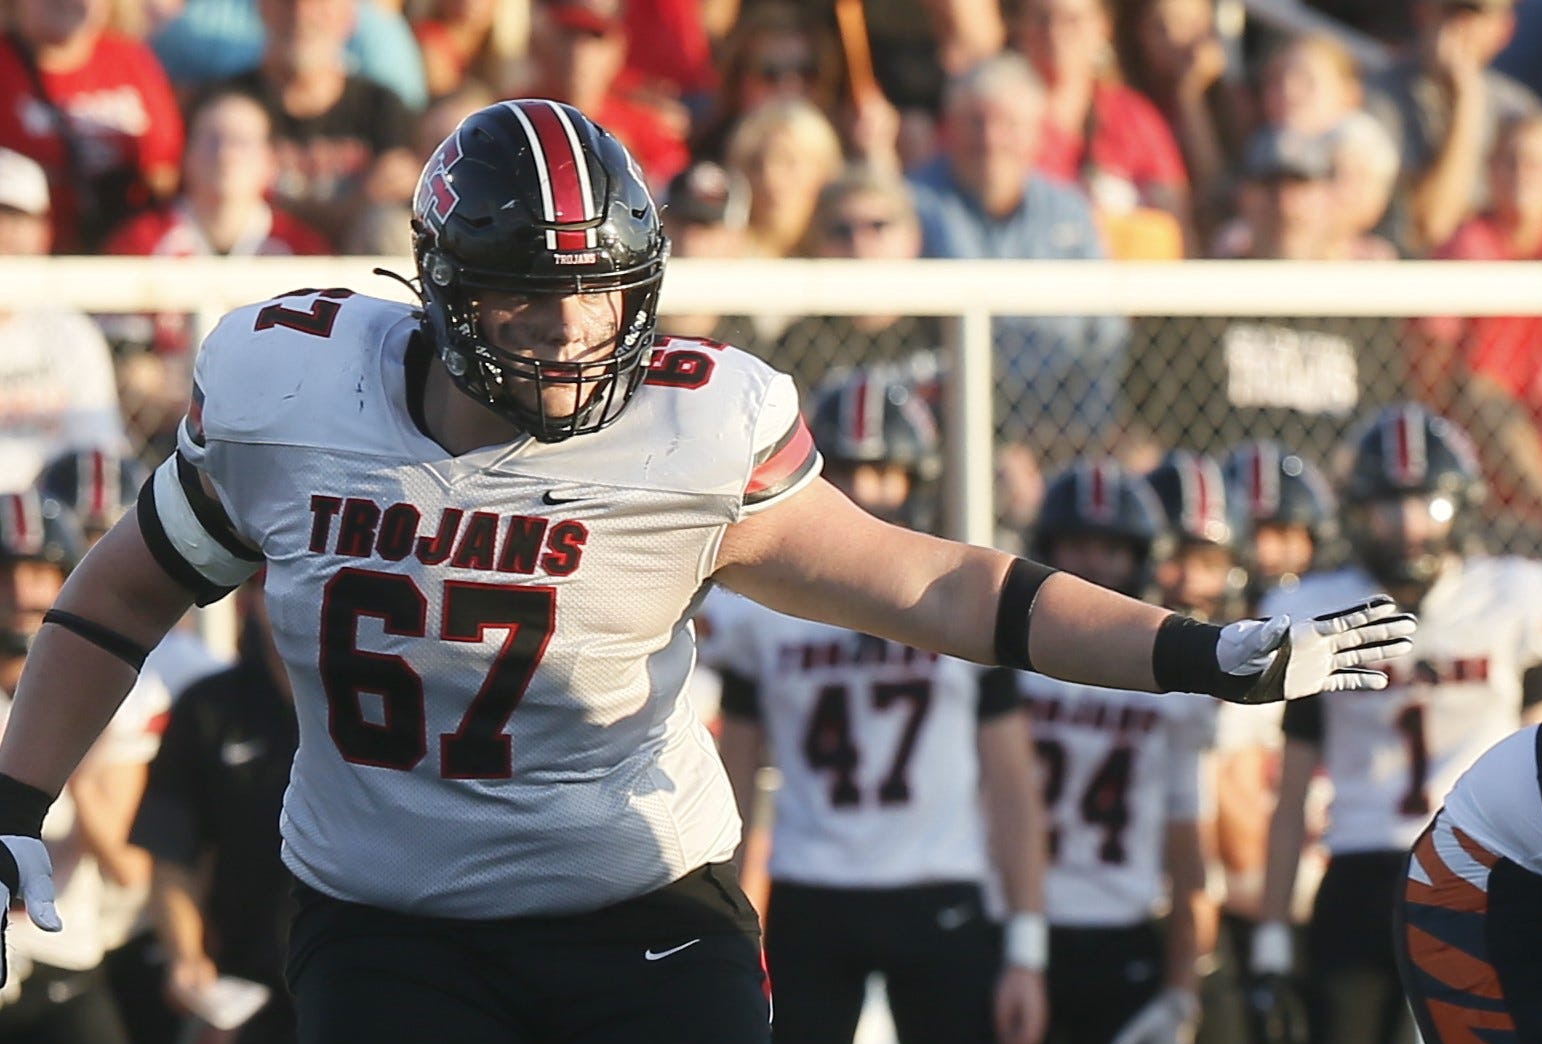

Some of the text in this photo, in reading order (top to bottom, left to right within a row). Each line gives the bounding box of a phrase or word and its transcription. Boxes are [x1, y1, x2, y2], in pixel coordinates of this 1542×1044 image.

[553, 253, 596, 265] TROJANS
[308, 494, 589, 577] TROJANS
[319, 566, 557, 780] 67
[803, 680, 933, 808] 47
[1394, 703, 1431, 816] 1
